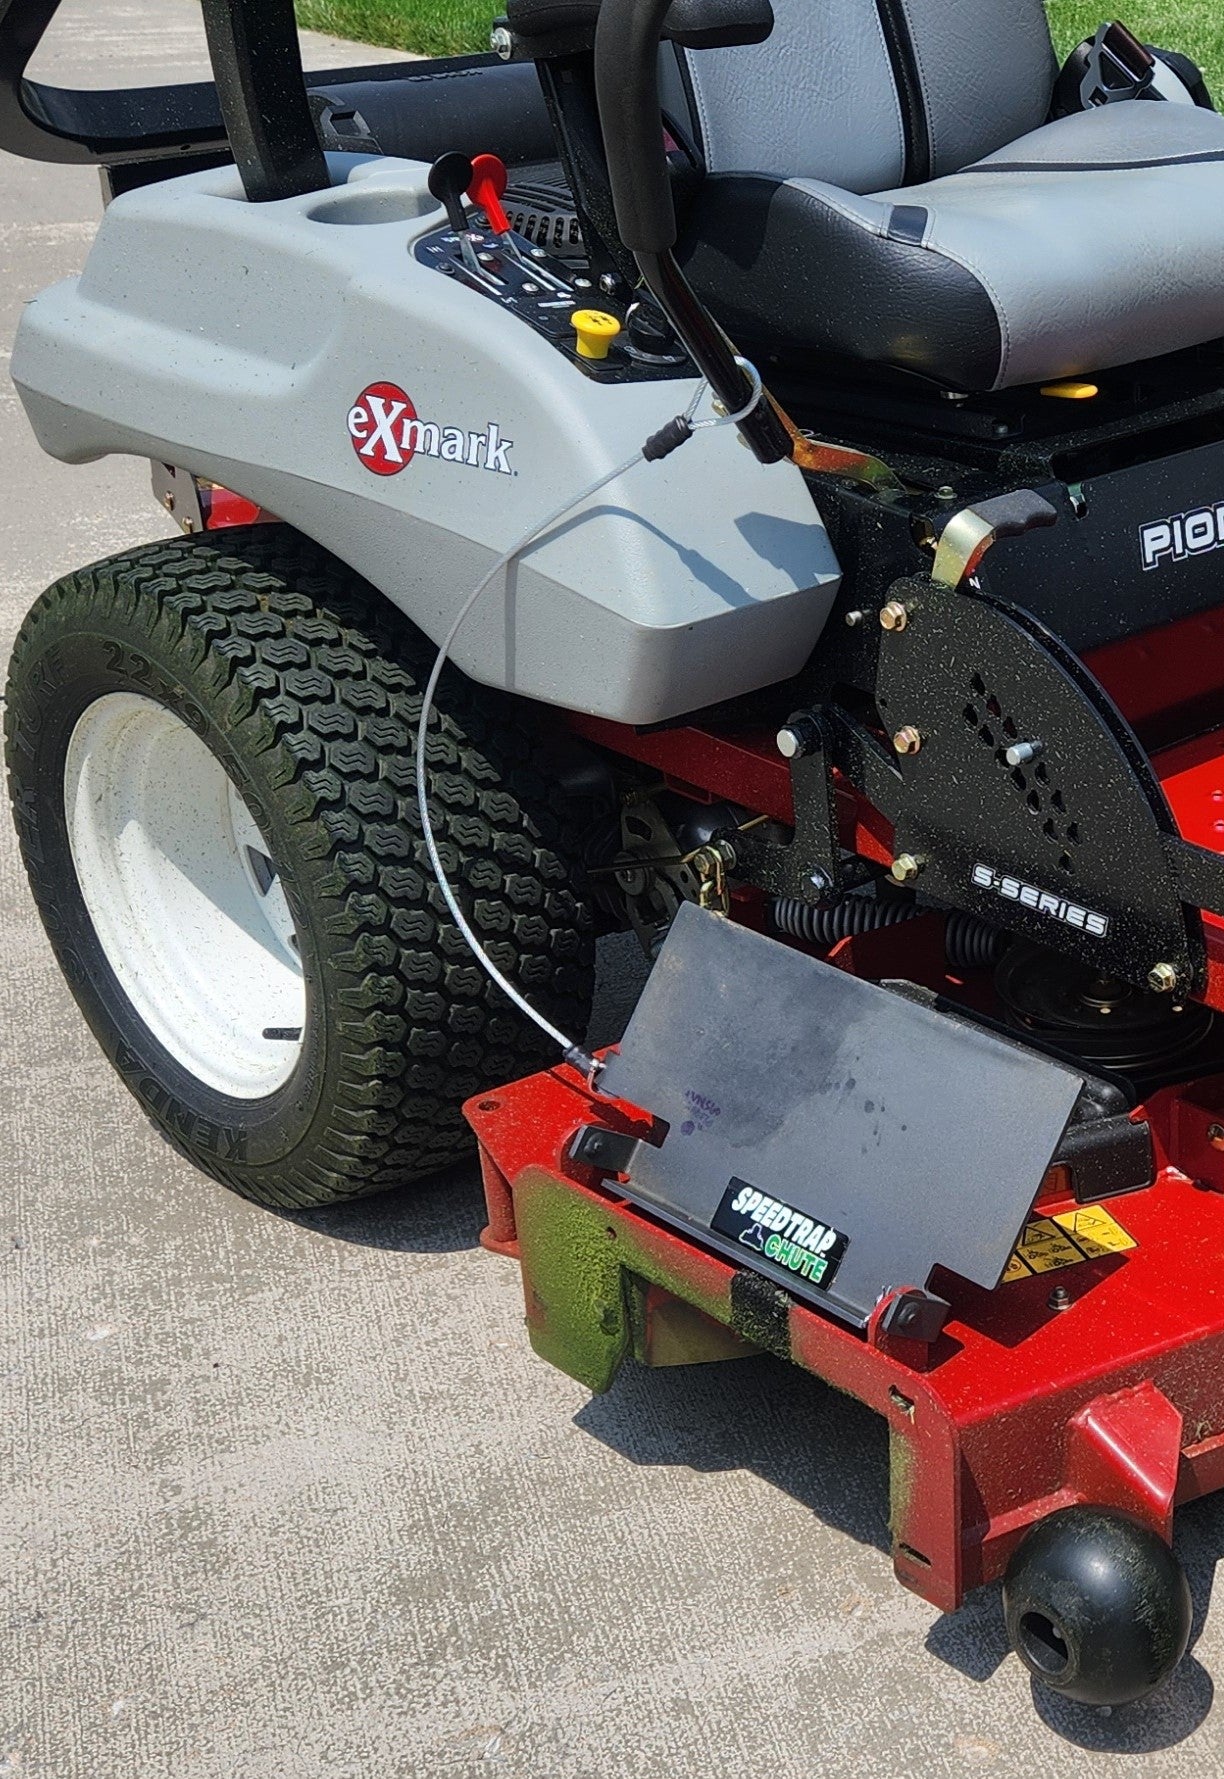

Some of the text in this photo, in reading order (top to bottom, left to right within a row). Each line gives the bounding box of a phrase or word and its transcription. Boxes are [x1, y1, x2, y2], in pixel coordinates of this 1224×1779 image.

[348, 393, 517, 475] eXmark
[972, 864, 1108, 937] S-SERIES
[110, 1036, 248, 1163] KENDA
[731, 1186, 837, 1255] SPEEDTRAP
[764, 1233, 829, 1284] CHUTE
